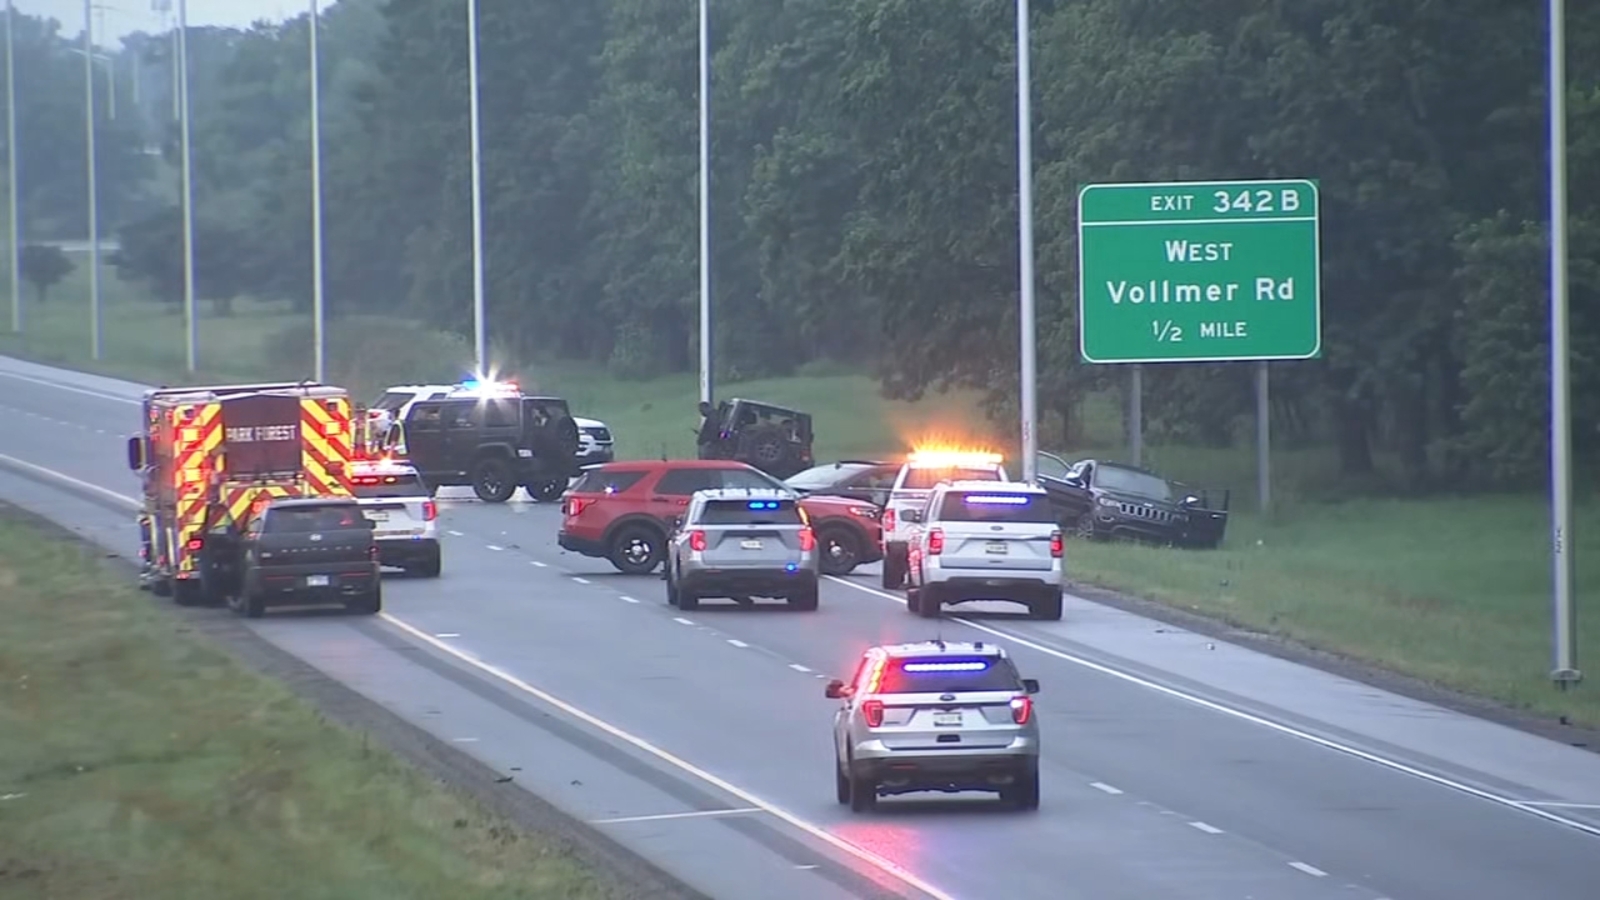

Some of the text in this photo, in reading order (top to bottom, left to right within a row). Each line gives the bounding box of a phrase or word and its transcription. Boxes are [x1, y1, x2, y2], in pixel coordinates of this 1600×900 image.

[1151, 195, 1194, 211] EXIT
[1165, 240, 1233, 262] WEST
[1106, 277, 1294, 304] Vollmer Rd
[1200, 322, 1247, 338] MILE
[226, 425, 297, 442] PARK FOREST
